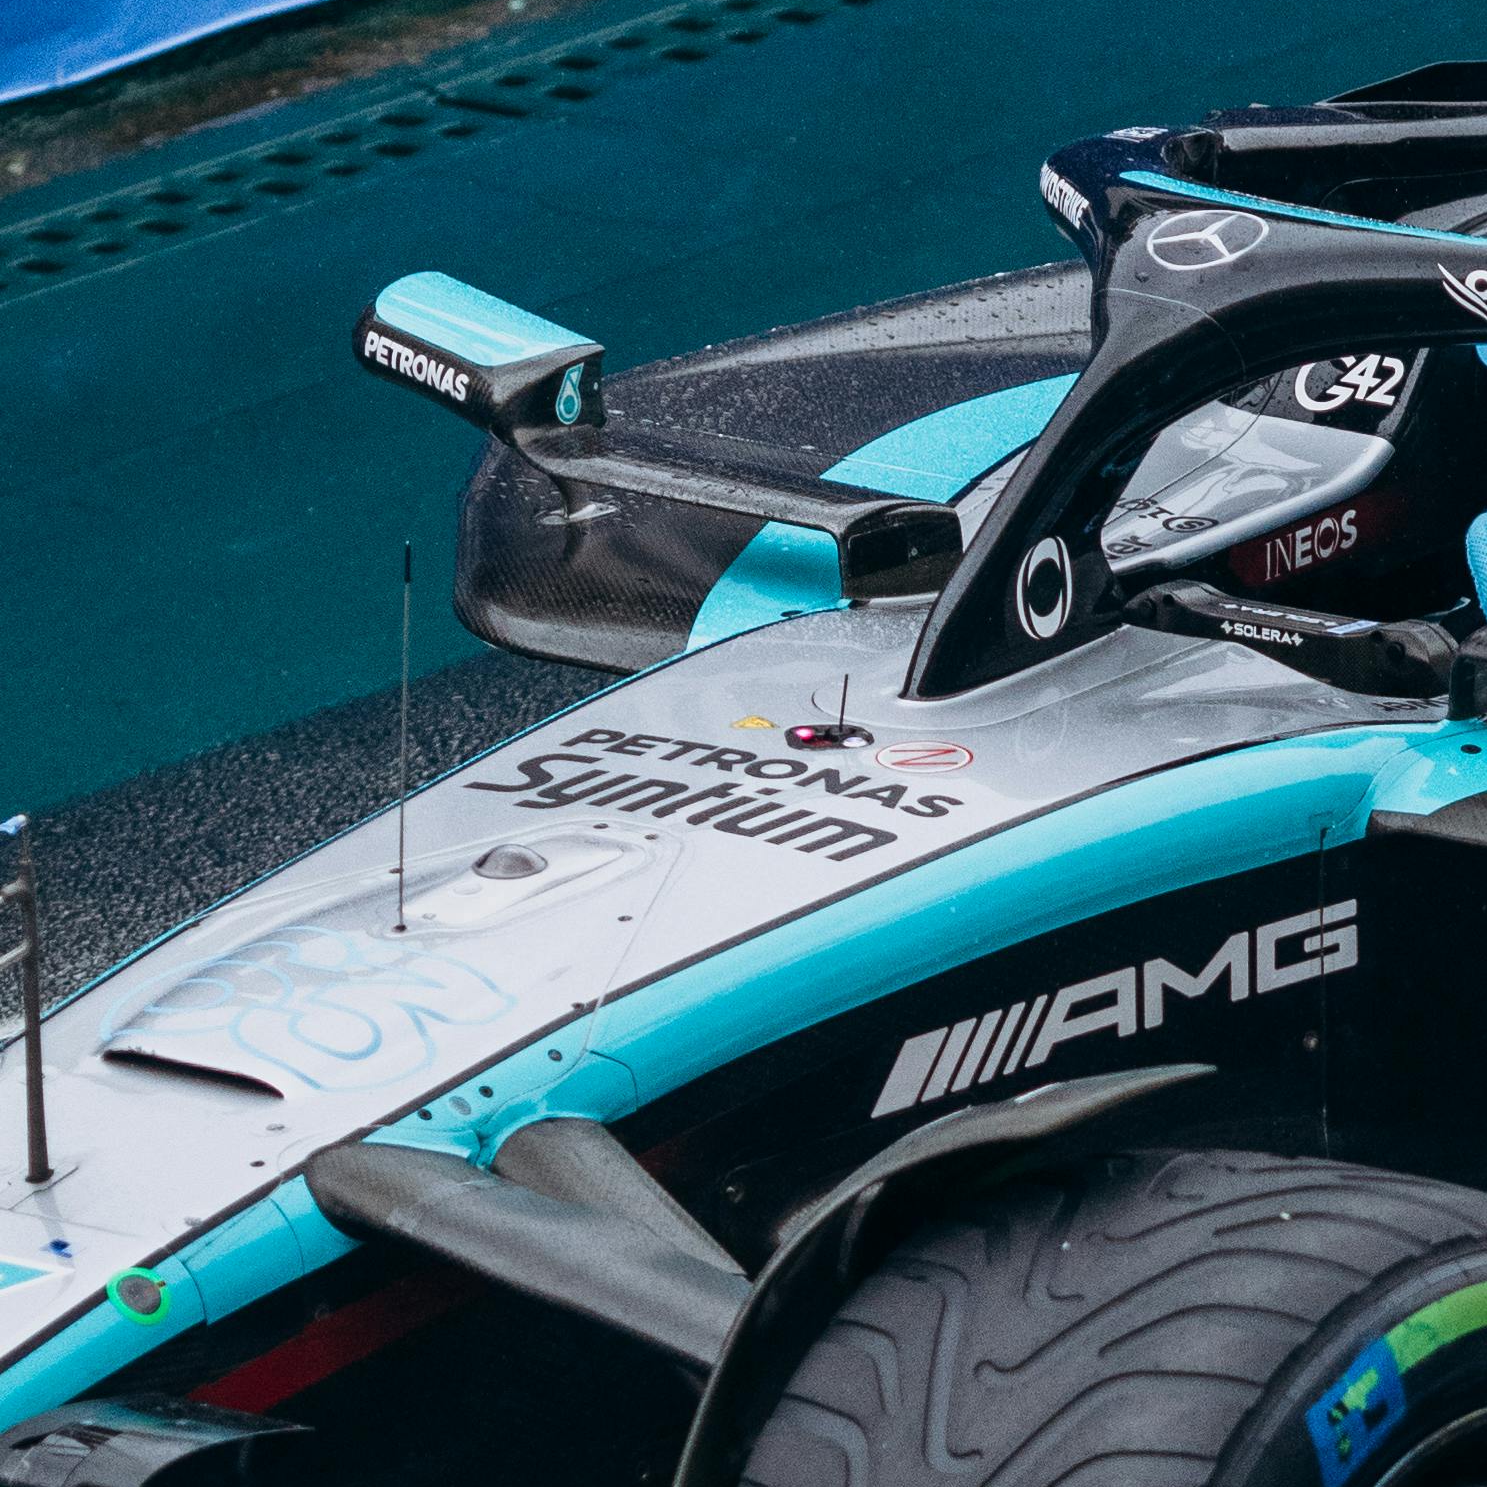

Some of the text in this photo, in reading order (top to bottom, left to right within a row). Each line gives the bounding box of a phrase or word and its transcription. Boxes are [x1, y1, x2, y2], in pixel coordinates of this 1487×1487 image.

[364, 330, 470, 402] PETRONAS
[1295, 354, 1405, 411] G42
[1264, 509, 1358, 582] INEOS
[1233, 622, 1292, 646] SOLERA
[462, 753, 899, 862] Syntium
[559, 727, 965, 818] PETRONAS
[1026, 899, 1359, 1068] AMG
